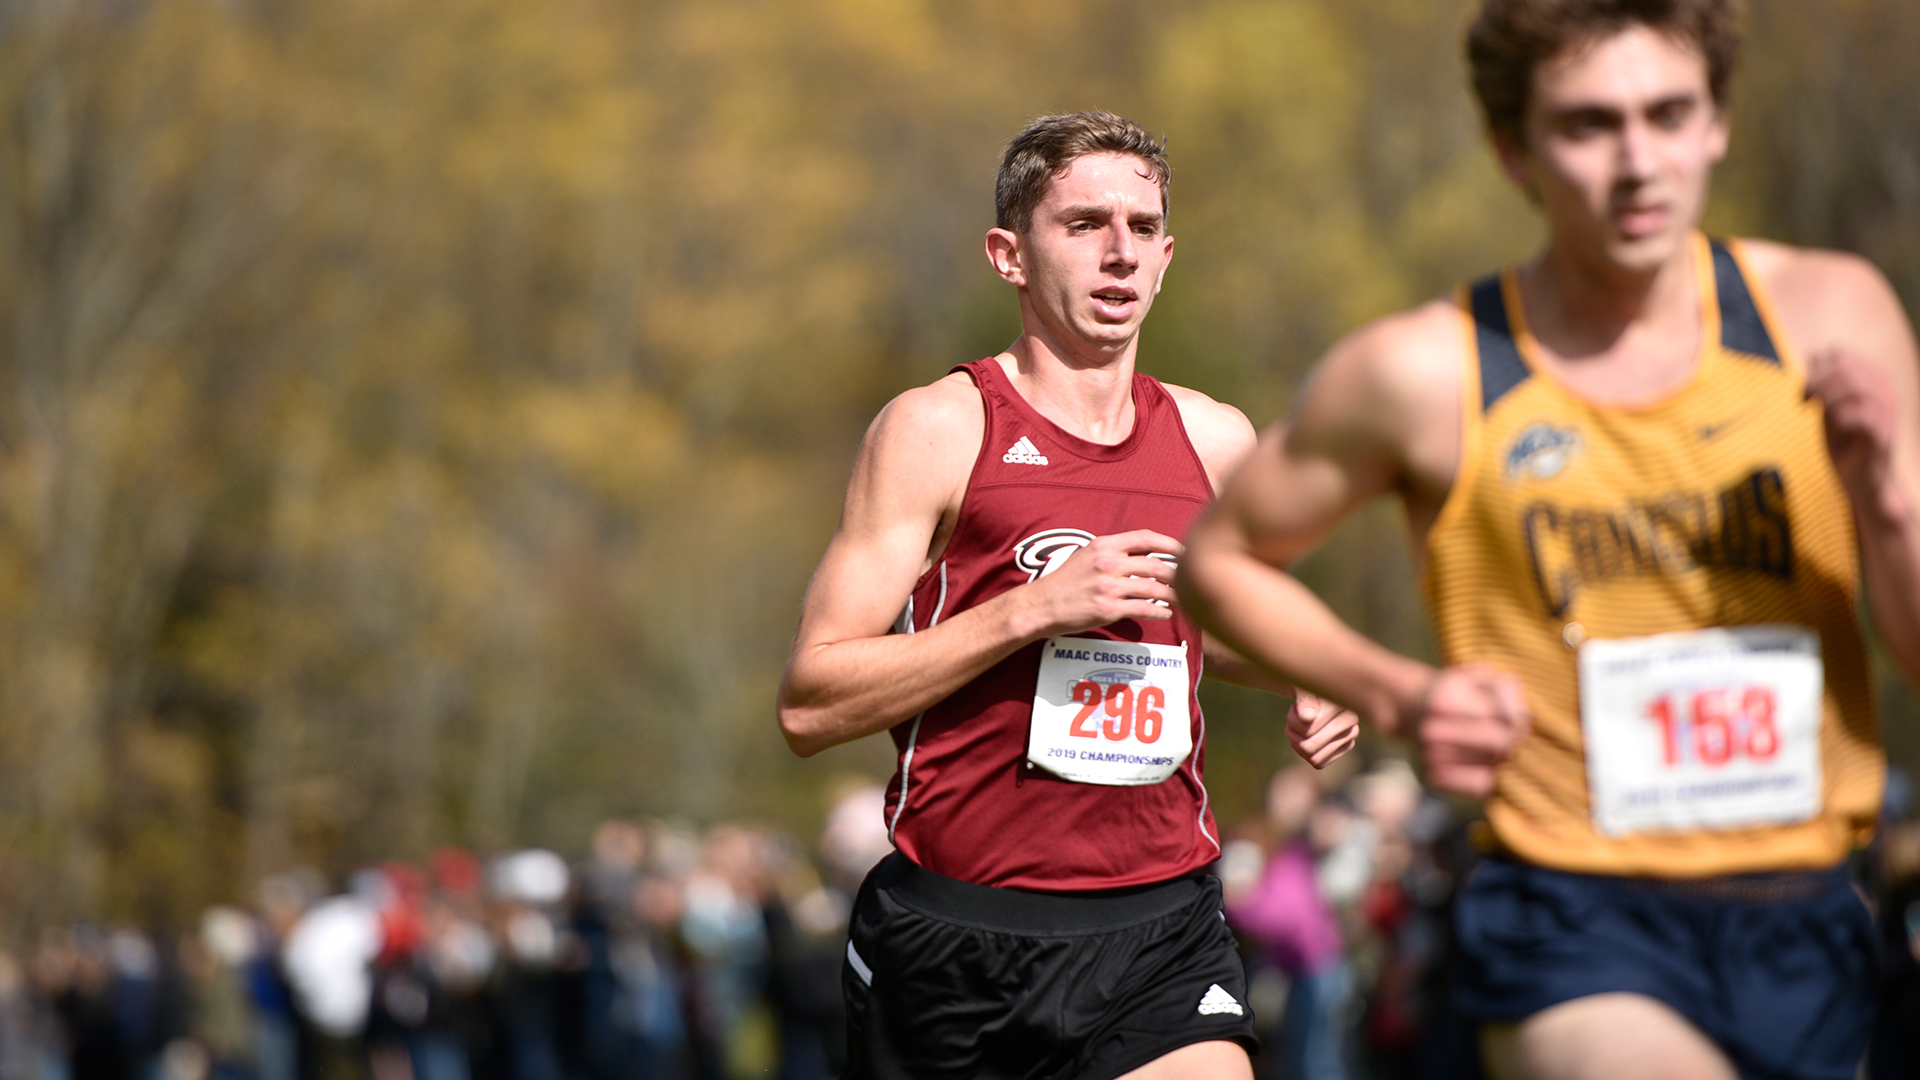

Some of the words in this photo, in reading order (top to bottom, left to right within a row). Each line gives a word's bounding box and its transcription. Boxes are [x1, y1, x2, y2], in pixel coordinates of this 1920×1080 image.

[1002, 451, 1049, 466] adidas
[1054, 648, 1091, 661] MAAC
[1093, 651, 1134, 665] CROSS
[1136, 655, 1183, 669] COUNTRY
[1069, 679, 1165, 744] 296
[1047, 747, 1077, 759] 2019
[1080, 750, 1175, 766] CHAMPIONSHIPS
